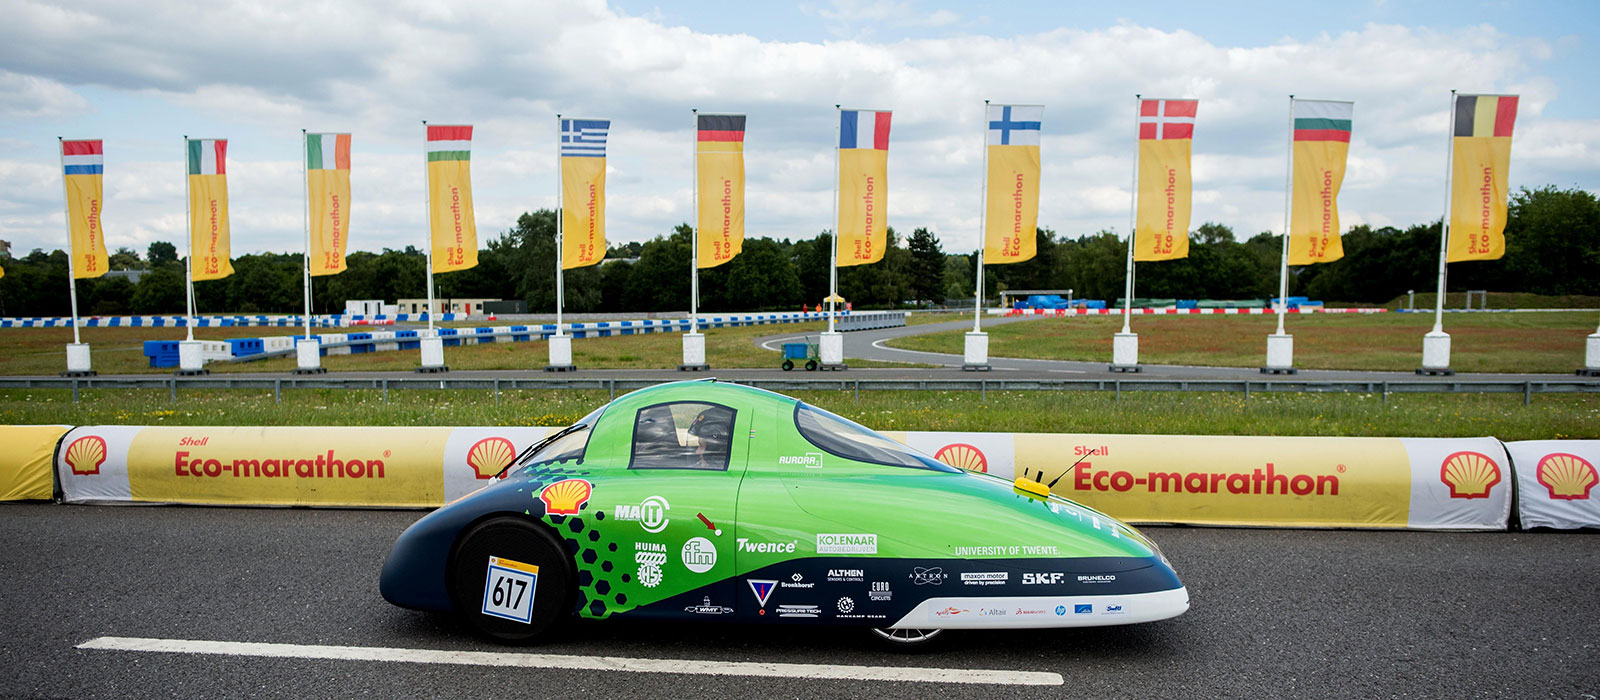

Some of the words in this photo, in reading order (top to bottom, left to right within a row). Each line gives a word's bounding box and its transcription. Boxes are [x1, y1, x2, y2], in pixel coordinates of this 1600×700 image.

[721, 179, 731, 260] Eco-marathon
[862, 176, 874, 260] Eco-marathon
[1010, 173, 1024, 257] Eco-marathon
[1162, 168, 1176, 255] Eco-marathon
[1478, 167, 1492, 255] Eco-marathon
[330, 195, 340, 270] Eco-marathon
[450, 187, 465, 266] Eco-marathon
[854, 239, 862, 260] Shell
[1002, 236, 1010, 257] Shell
[1154, 233, 1162, 254] Shell
[1309, 236, 1318, 258] Shell
[1469, 233, 1477, 254] Shell
[179, 437, 209, 446] Shell
[1074, 445, 1109, 457] Shell
[175, 450, 385, 478] Eco-marathon
[1074, 462, 1340, 496] Eco-marathon
[635, 542, 667, 553] HUIMA
[736, 537, 796, 553] Twence
[819, 535, 875, 545] KOLENAAR
[955, 546, 1007, 556] UNIVERSITY
[1009, 546, 1020, 555] OF
[684, 540, 714, 565] ifm
[492, 576, 528, 610] 617
